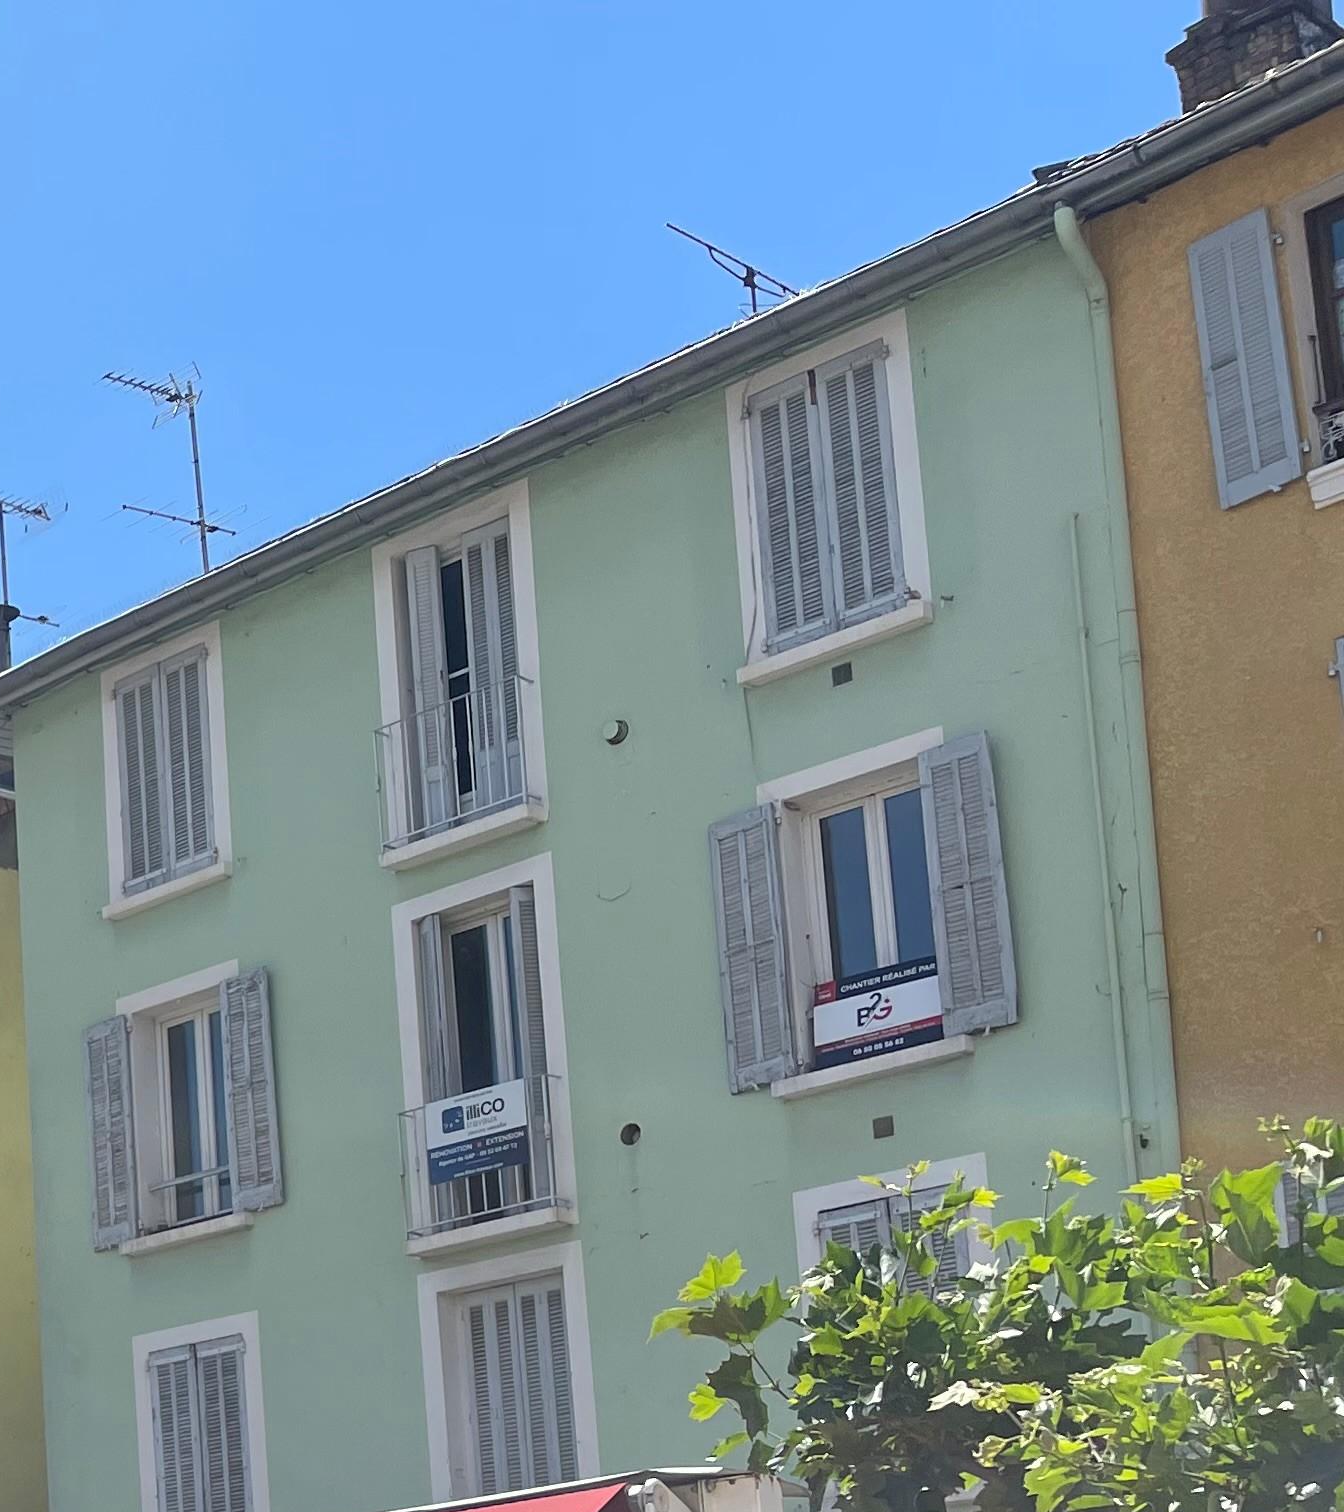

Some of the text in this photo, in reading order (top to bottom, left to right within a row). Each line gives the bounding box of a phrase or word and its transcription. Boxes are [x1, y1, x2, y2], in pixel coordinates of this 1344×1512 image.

[840, 976, 881, 993] CHANTIER
[882, 966, 917, 982] RÉALISÉ
[918, 962, 936, 973] PAR
[485, 1131, 525, 1146] EXTENSION
